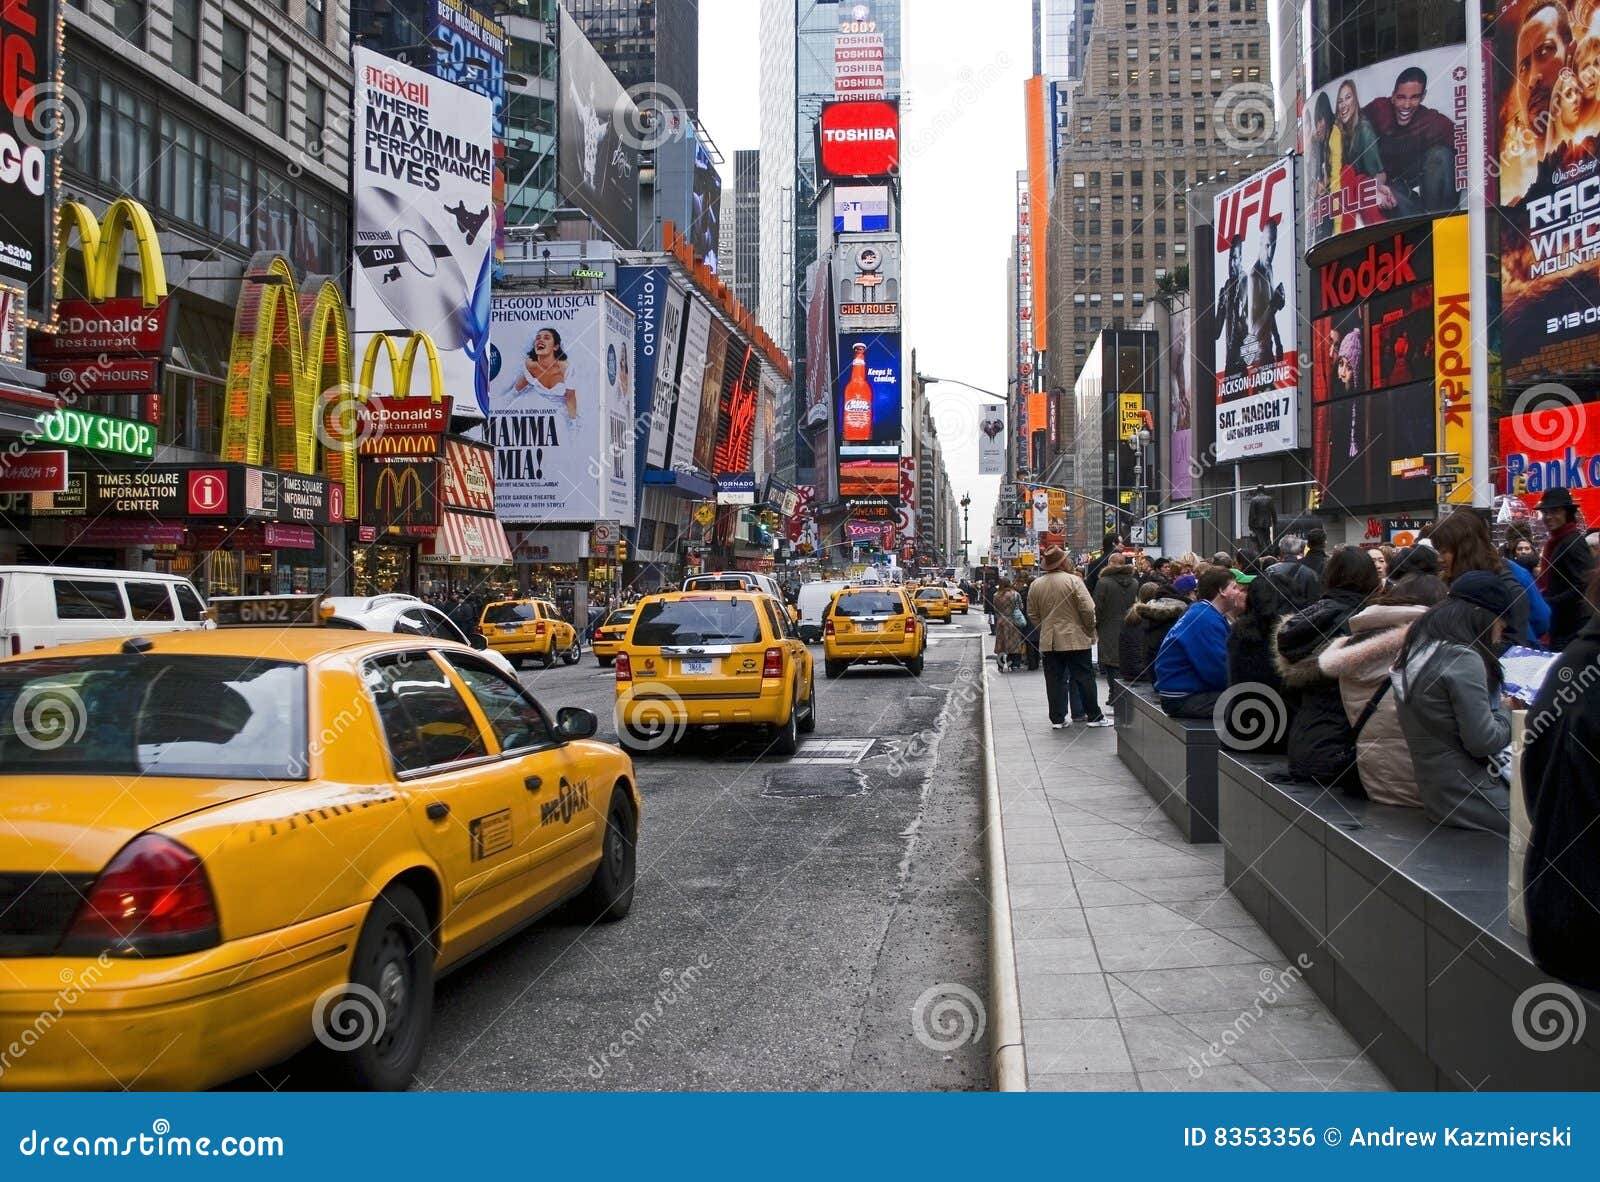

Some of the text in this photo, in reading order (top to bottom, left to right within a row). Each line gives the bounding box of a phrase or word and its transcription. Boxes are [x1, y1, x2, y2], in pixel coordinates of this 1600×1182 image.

[438, 1, 454, 22] BEST
[455, 12, 481, 40] MUSICAL
[842, 22, 877, 33] 2009
[836, 37, 883, 45] TOSHIBA
[836, 50, 883, 60] TOSHIBA
[836, 64, 883, 73] TOSHIBA
[366, 65, 429, 107] maxell
[836, 79, 883, 87] TOSHIBA
[367, 90, 429, 125] WHERE
[366, 107, 490, 170] MAXIMUM
[824, 128, 896, 142] TOSHIBA
[1454, 85, 1468, 192] SOUTHPOLE
[366, 130, 490, 186] PERFORMANCE
[365, 146, 440, 191] LIVES
[1217, 167, 1286, 253] UFC
[1307, 179, 1377, 232] HPOLE
[1568, 212, 1583, 225] TO
[358, 231, 393, 241] maxell
[374, 249, 394, 260] DVD
[576, 270, 604, 278] LAMAR
[1320, 234, 1416, 311] Kodak
[549, 295, 596, 308] MUSICAL
[643, 270, 654, 356] VORNADO
[841, 304, 897, 315] CHEVROLET
[59, 315, 159, 334] cDonald's
[55, 336, 137, 348] Restaurant
[1437, 293, 1471, 428] Kodak
[102, 370, 149, 382] HOURS
[868, 368, 886, 376] Keeps
[1218, 376, 1250, 397] JACKSON
[1251, 366, 1290, 388] JARDINE
[357, 408, 443, 421] McDonald's
[1241, 399, 1280, 425] MARCH
[1283, 397, 1290, 416] 7
[371, 422, 428, 430] Restaurant
[481, 415, 559, 446] MAMMA
[1245, 420, 1280, 437] PAY-PER-VIEW
[97, 418, 153, 456] SHOP.
[497, 448, 543, 480] MIA!
[45, 466, 58, 478] 19
[97, 473, 179, 485] TIMES SQUARE
[100, 486, 177, 499] INFORMATION
[284, 477, 323, 494] TIMES SQUARE
[117, 499, 159, 511] CENTER
[284, 493, 322, 507] INFORMATION
[292, 507, 314, 520] CENTER
[240, 601, 289, 622] 6N52
